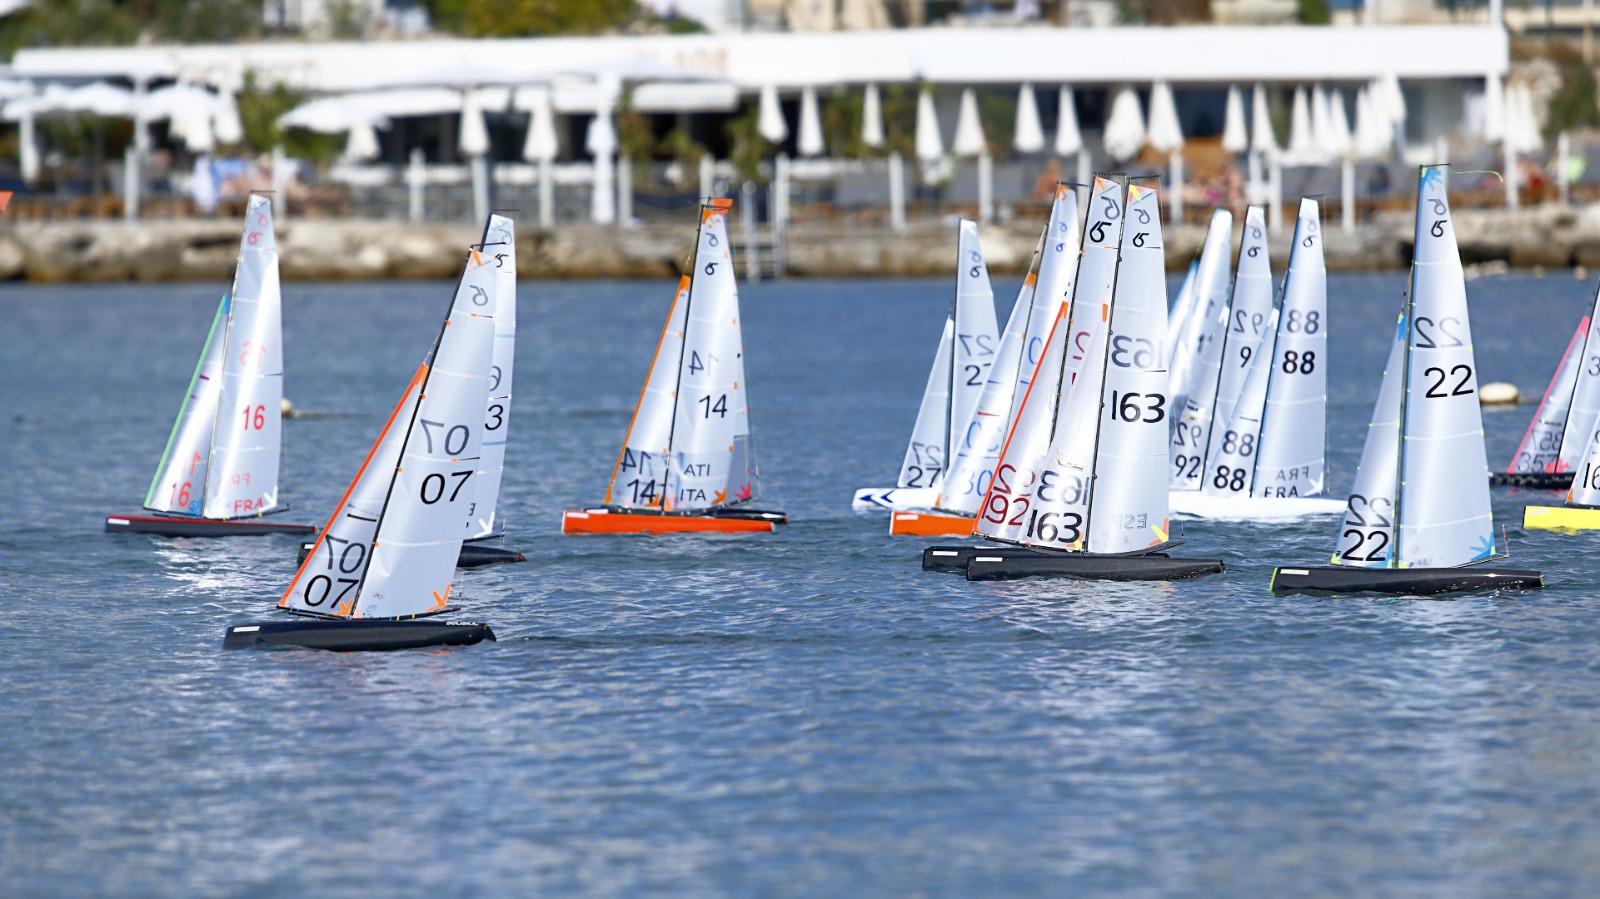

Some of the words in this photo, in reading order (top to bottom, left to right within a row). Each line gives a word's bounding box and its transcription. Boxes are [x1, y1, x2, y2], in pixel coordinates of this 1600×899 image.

[1282, 350, 1316, 375] 88
[1424, 364, 1474, 399] 22
[242, 405, 265, 430] 16
[699, 393, 727, 419] 14
[1111, 390, 1166, 424] 163
[907, 465, 941, 489] 27
[1175, 454, 1201, 479] 92
[1213, 465, 1246, 492] 88
[169, 481, 192, 508] 16
[420, 470, 473, 505] 07
[627, 478, 656, 503] 14
[680, 488, 706, 501] ITA
[1263, 485, 1299, 498] FRA
[233, 498, 264, 513] FRA
[981, 491, 1030, 526] 192
[1026, 509, 1083, 544] 163
[1341, 528, 1389, 562] 22
[304, 574, 360, 609] 07
